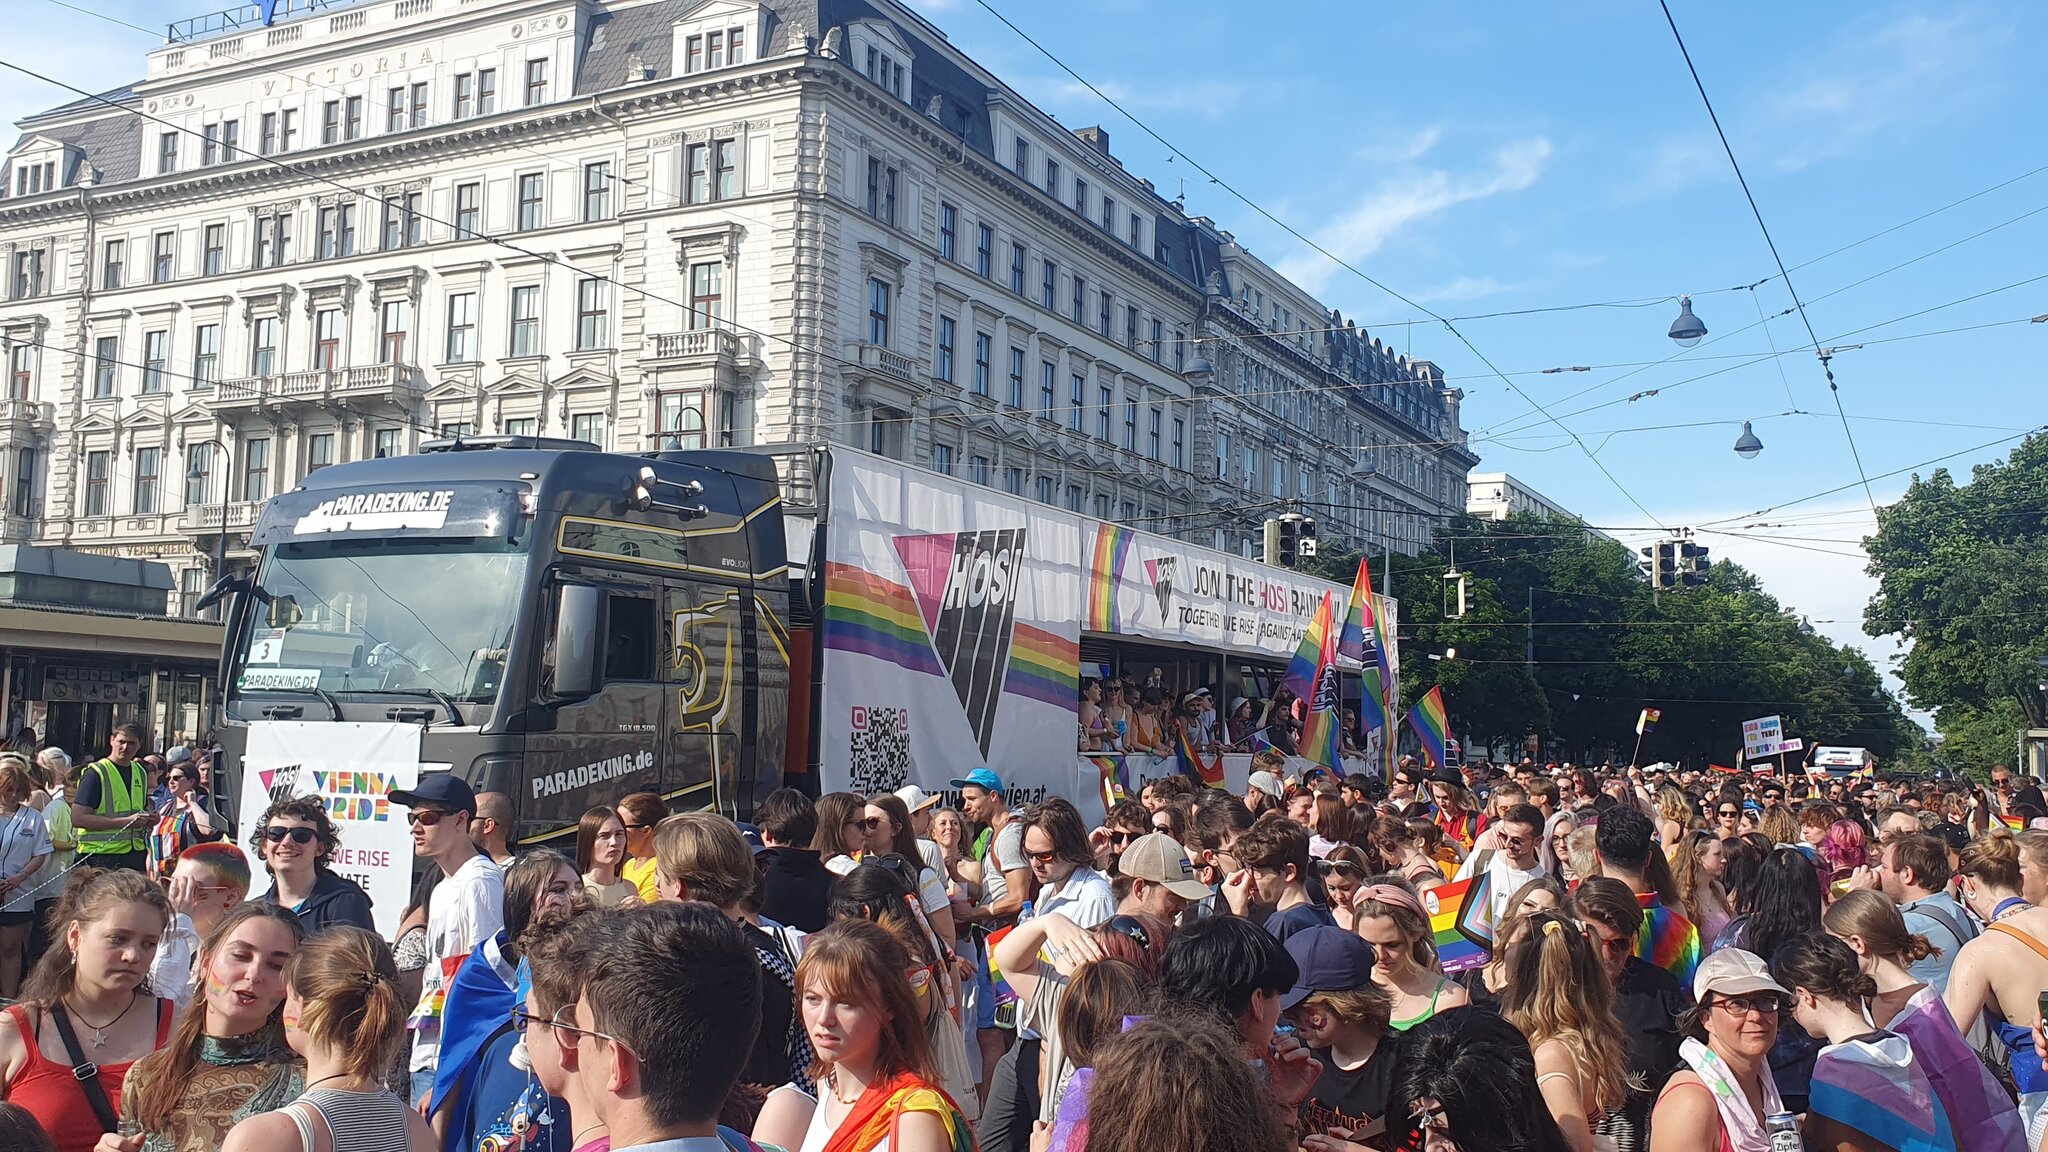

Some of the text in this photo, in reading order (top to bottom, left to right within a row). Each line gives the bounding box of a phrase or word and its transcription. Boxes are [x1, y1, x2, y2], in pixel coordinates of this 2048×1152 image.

[263, 47, 434, 96] VICTORIA
[333, 490, 455, 516] PARADEKING.DE
[944, 548, 1022, 611] HOSI
[1226, 573, 1255, 606] THE
[1259, 580, 1289, 613] HOSI
[1240, 618, 1255, 635] RISE
[1290, 626, 1307, 642] HAT
[260, 642, 270, 660] 3
[245, 675, 317, 689] PARADEKING.DE
[312, 770, 400, 795] VIENNA
[532, 749, 654, 800] PARADEKING.de
[358, 849, 391, 868] RISE
[1775, 1141, 1801, 1152] Zipfer
